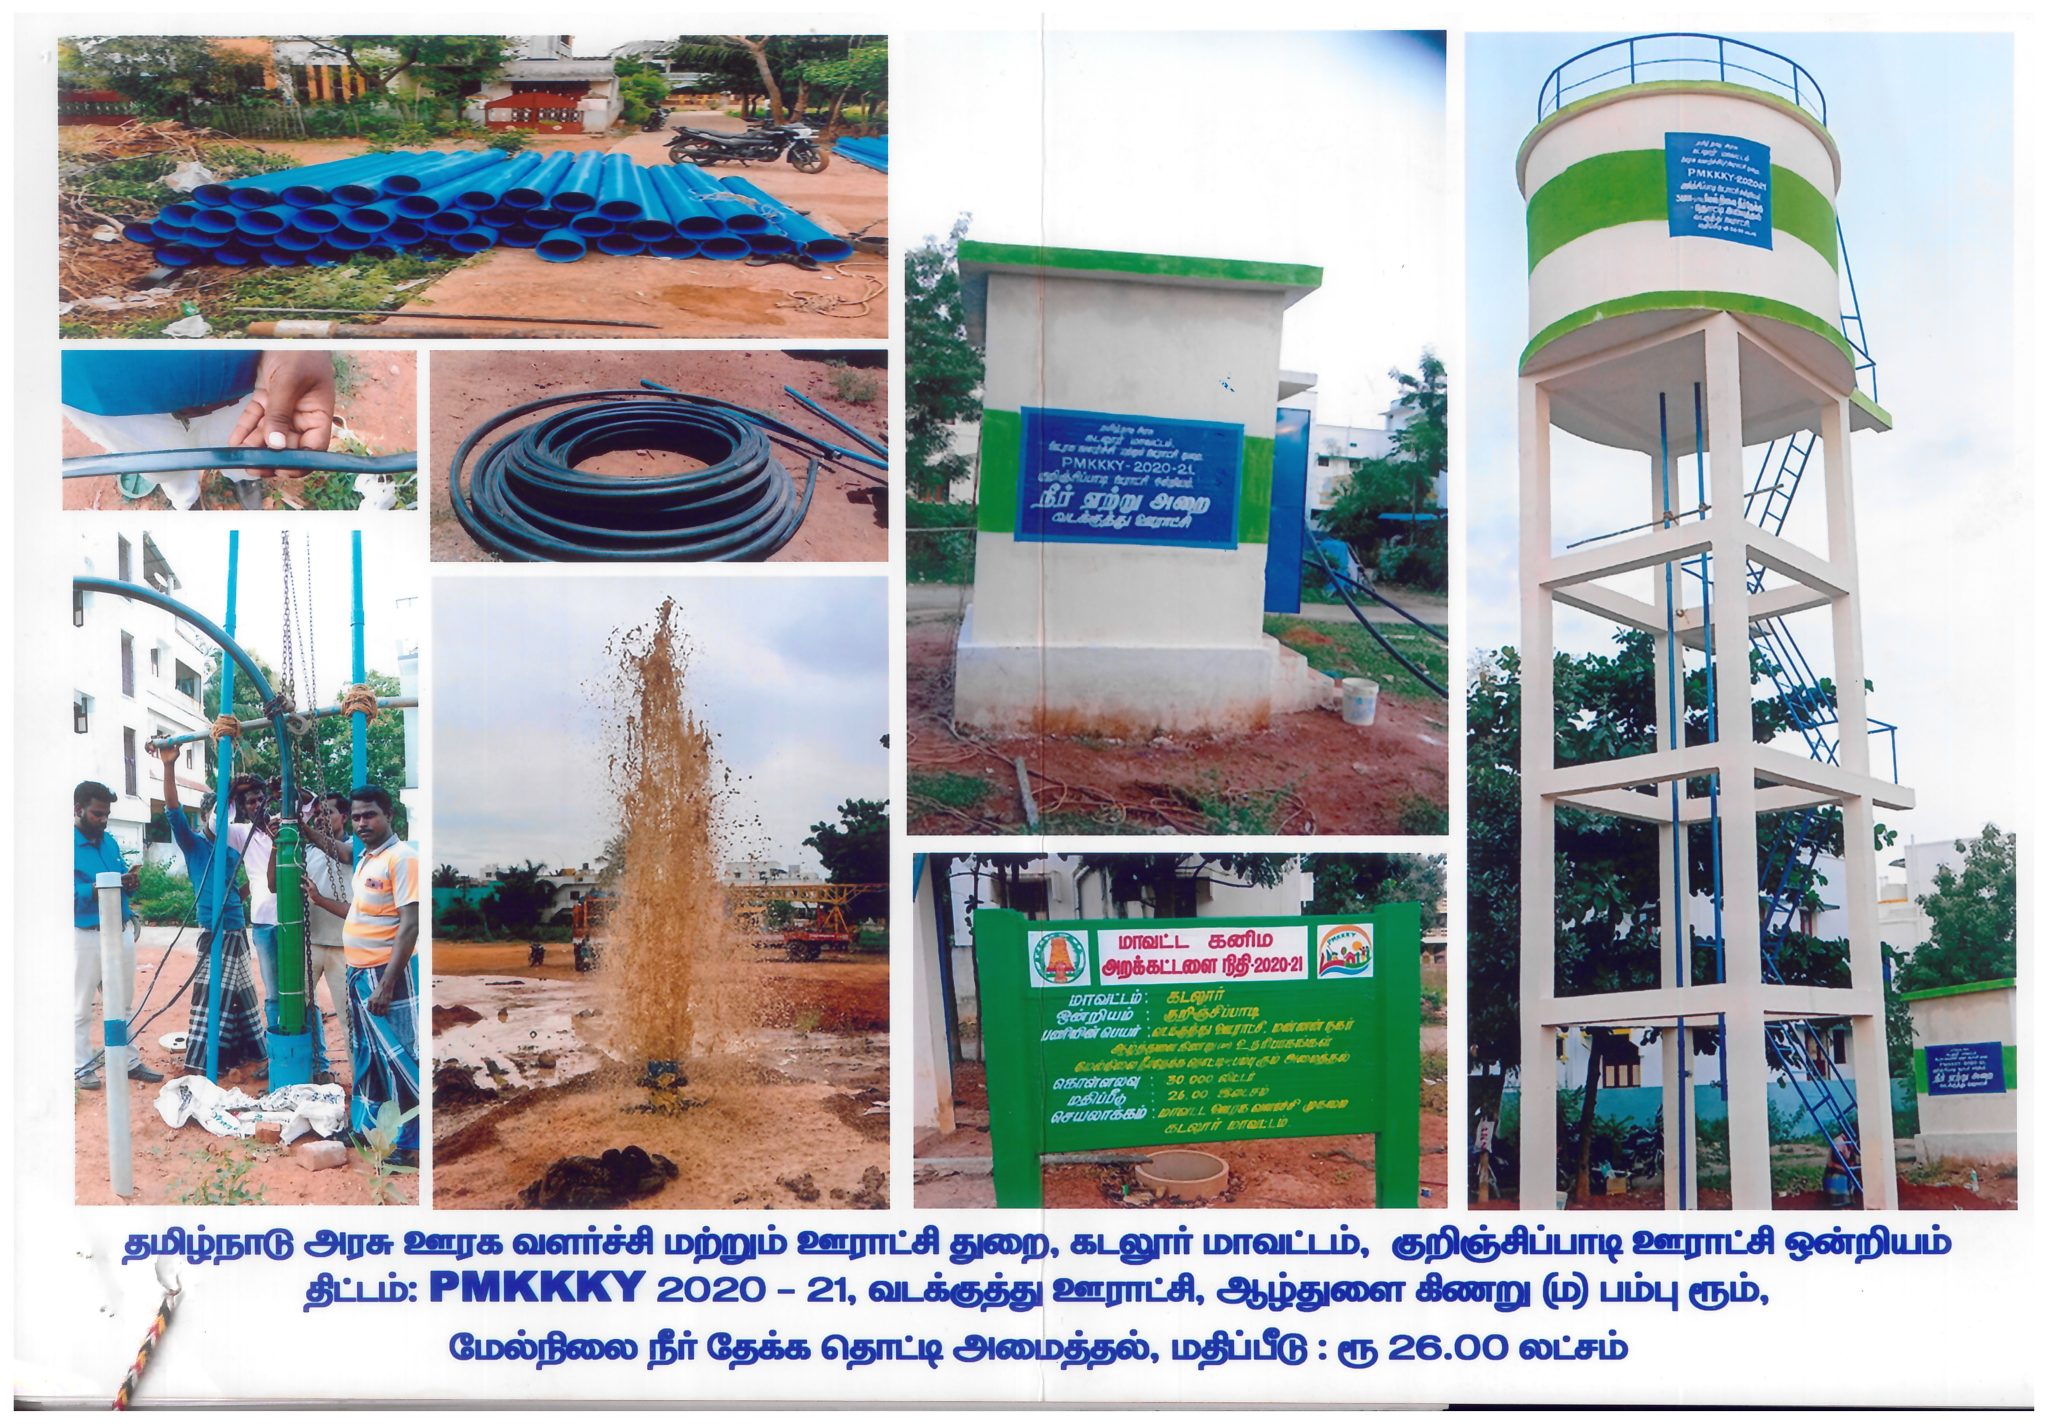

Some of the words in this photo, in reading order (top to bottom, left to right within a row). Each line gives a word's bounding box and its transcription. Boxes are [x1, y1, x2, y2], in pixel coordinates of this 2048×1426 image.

[1150, 493, 1211, 514] அறை
[1118, 933, 1190, 950] மாவட்ட
[1207, 930, 1274, 950] கனிம
[1101, 954, 1218, 980] அறக்கட்டளை
[1166, 986, 1226, 1006] கடலூர்
[1056, 1006, 1134, 1025] ஒன்றியம்
[122, 1225, 294, 1264] தமிழ்நாடு
[304, 1230, 394, 1260] அரசு
[404, 1231, 503, 1260] ஊரக
[513, 1224, 653, 1255] வளர்ச்சி
[665, 1224, 787, 1265] மற்றும்
[797, 1225, 939, 1260] ஊராட்சி
[949, 1233, 1059, 1264] துறை,
[1070, 1225, 1193, 1265] கடலூர்
[1204, 1224, 1369, 1258] மாவட்டம்,
[1392, 1224, 1624, 1264] குறிஞ்சிப்பாடி
[1632, 1225, 1774, 1260] ஊராட்சி
[1785, 1224, 1952, 1264] ஒன்றியம்
[304, 1272, 417, 1312] திட்டம்:
[430, 1270, 645, 1302] PMKKKY
[657, 1276, 766, 1302] 2020
[808, 1277, 856, 1305] 21,
[869, 1272, 1043, 1312] வடக்குத்து
[1053, 1272, 1204, 1307] ஊராட்சி,
[1217, 1271, 1406, 1312] ஆழ்துளை
[1416, 1272, 1530, 1312] கிணறு
[1543, 1271, 1588, 1310] (ம)
[1600, 1271, 1678, 1311] பம்பு
[1689, 1271, 1768, 1311] ரூம்,
[450, 1329, 638, 1370] மேல்நிலை
[648, 1328, 698, 1370] நீர்
[707, 1330, 811, 1370] தேக்க
[821, 1334, 944, 1370] தொட்டி
[953, 1329, 1159, 1370] அமைத்தல்,
[1172, 1327, 1307, 1370] மதிப்பீடு
[1389, 1334, 1509, 1360] 26.00
[1519, 1329, 1628, 1360] லட்சம்
